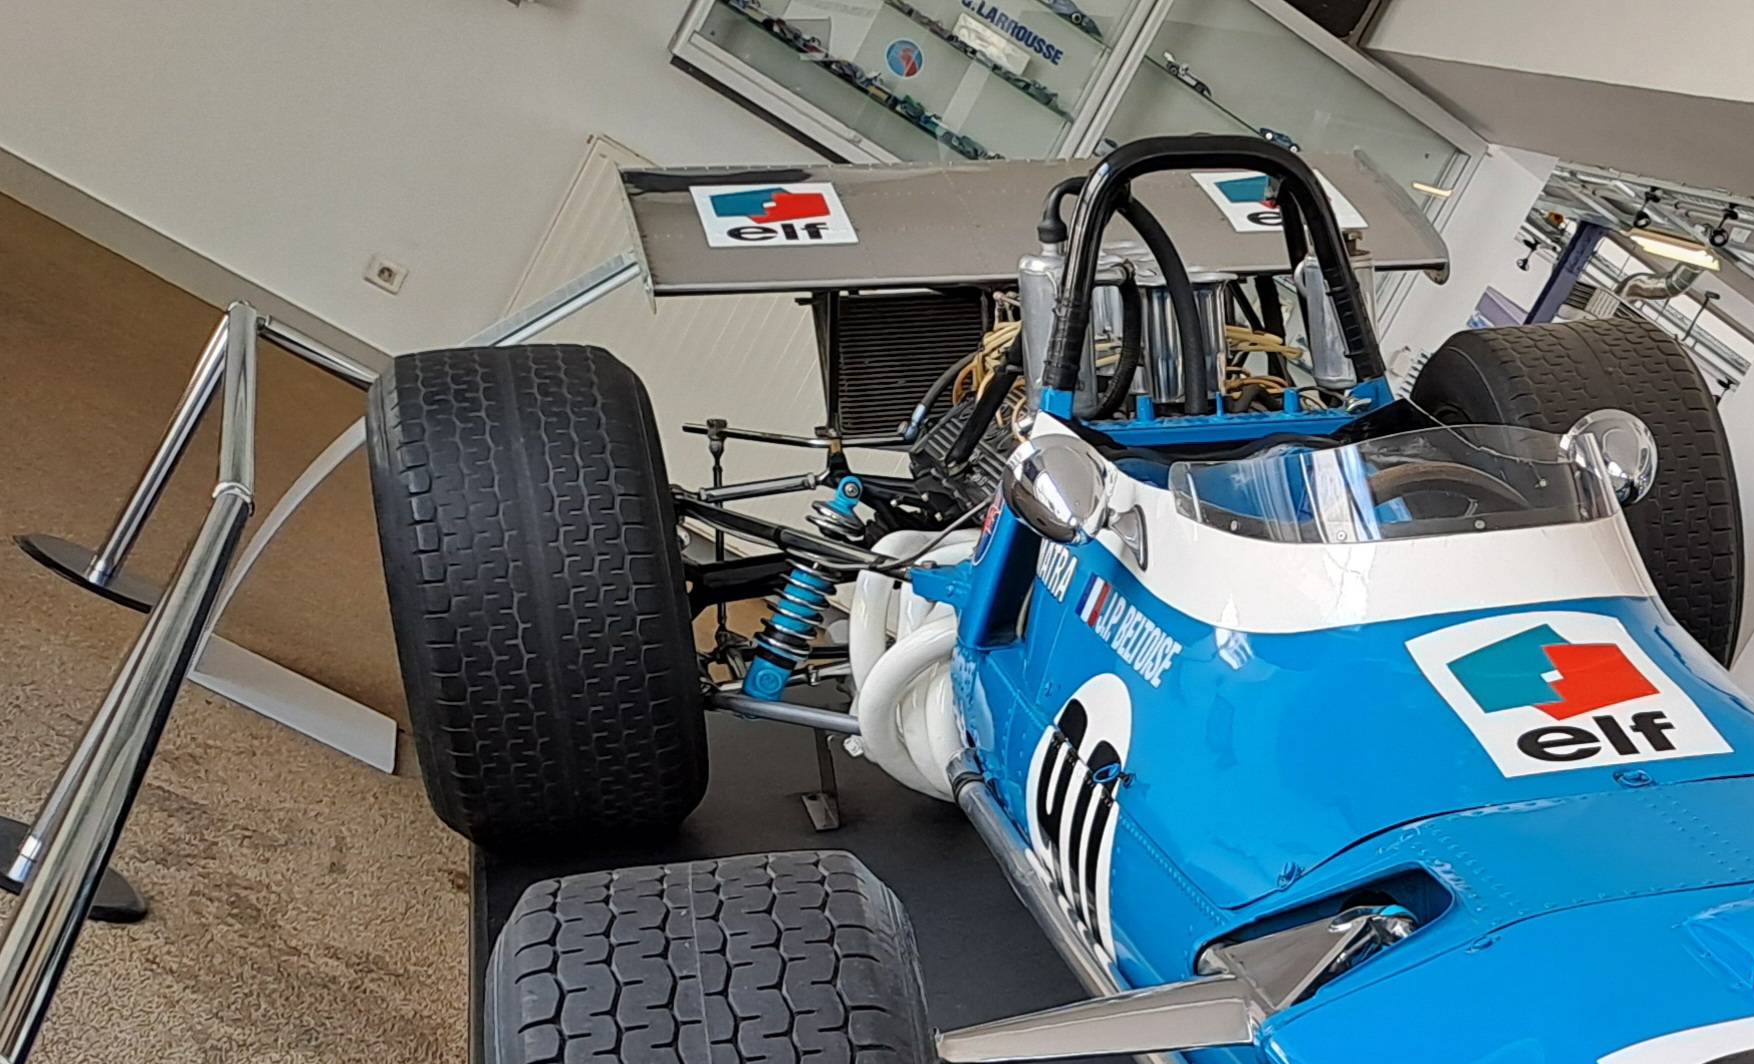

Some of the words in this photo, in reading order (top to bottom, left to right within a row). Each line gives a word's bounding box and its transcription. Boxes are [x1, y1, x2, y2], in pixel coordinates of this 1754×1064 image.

[727, 222, 829, 241] elf
[1111, 605, 1183, 688] BELTOISE
[1517, 711, 1677, 762] elf
